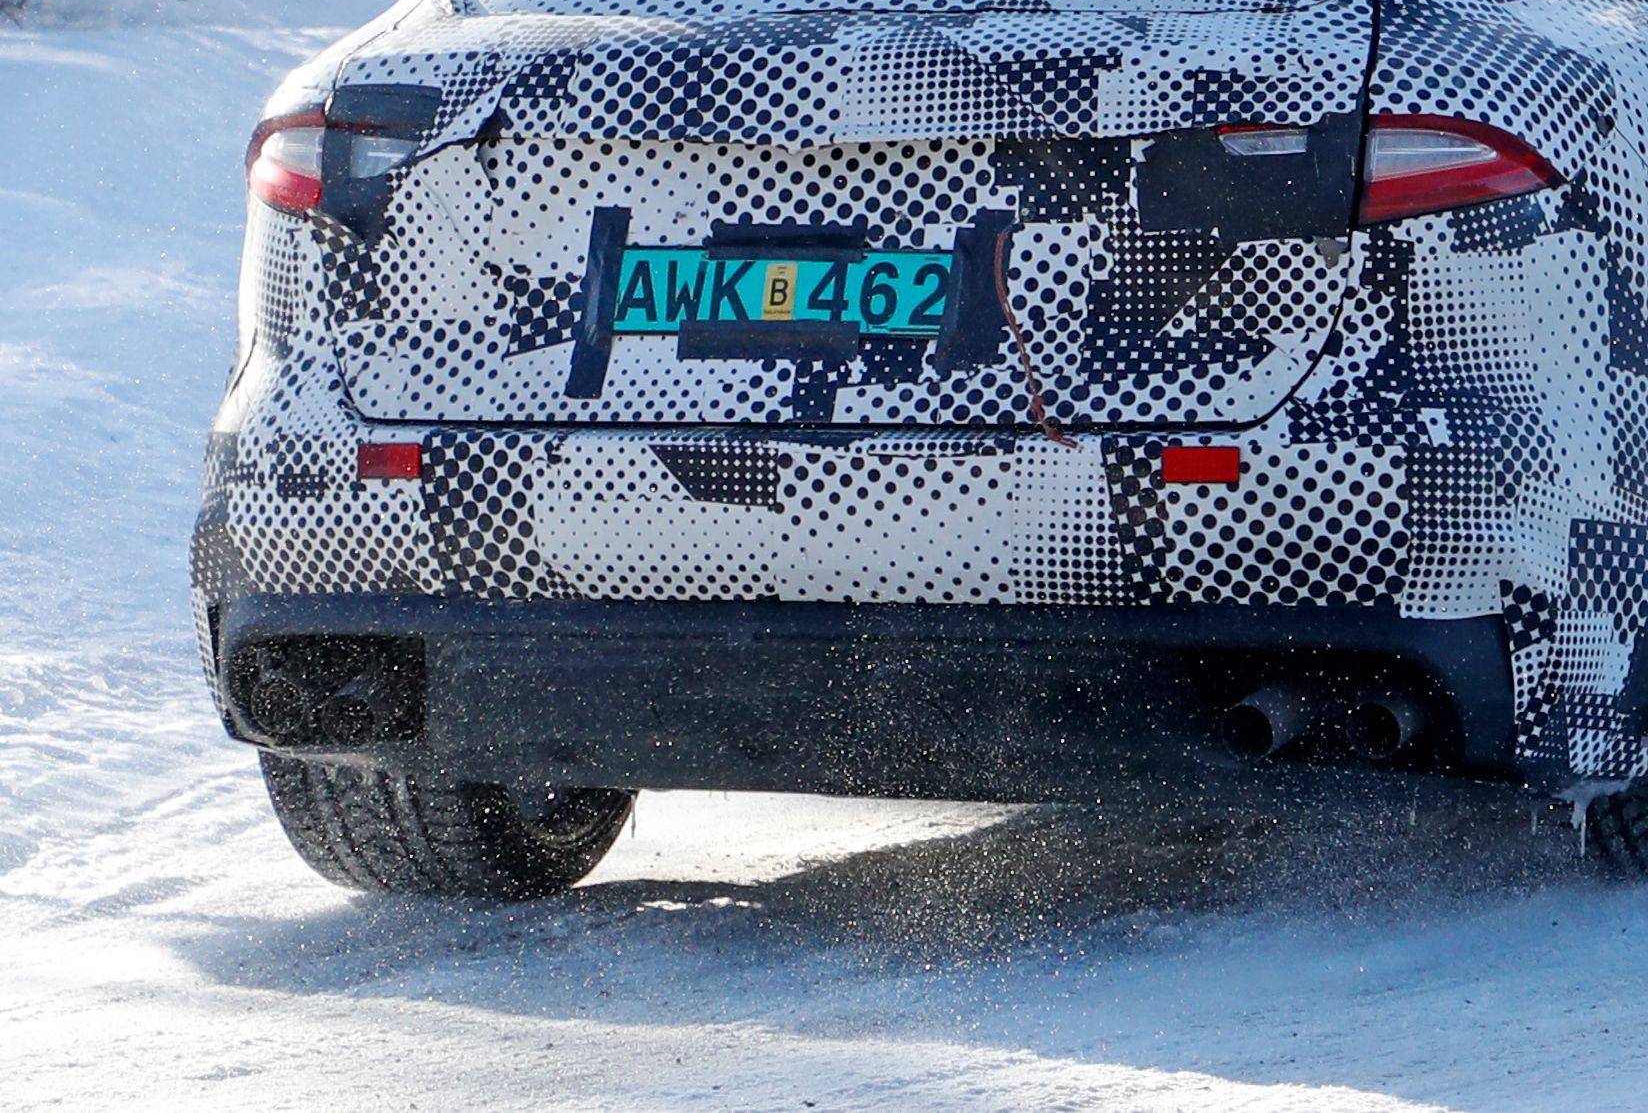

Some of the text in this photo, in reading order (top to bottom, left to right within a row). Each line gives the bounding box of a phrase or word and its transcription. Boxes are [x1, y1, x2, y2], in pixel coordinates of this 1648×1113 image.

[615, 259, 951, 326] AWK B 462
